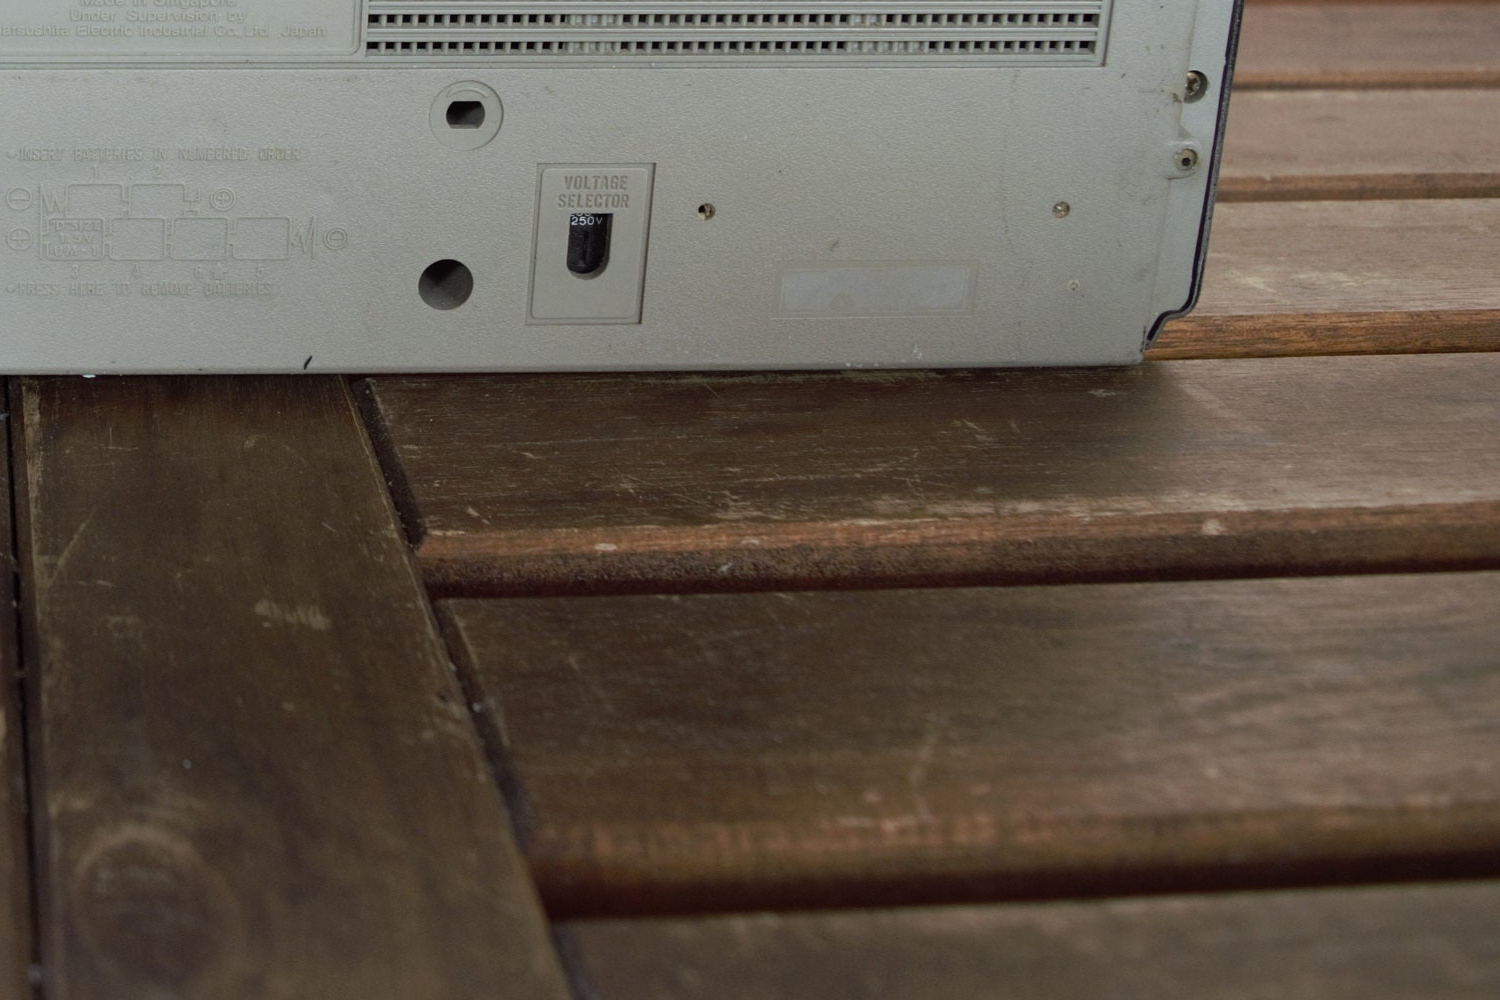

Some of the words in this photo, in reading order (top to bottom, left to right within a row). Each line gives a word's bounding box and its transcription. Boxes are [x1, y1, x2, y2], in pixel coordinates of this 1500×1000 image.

[70, 9, 118, 22] Under
[127, 10, 220, 26] Supervision
[228, 10, 247, 24] by
[76, 24, 133, 38] Electric
[139, 25, 207, 38] Industrial
[281, 25, 326, 40] Japan
[564, 175, 629, 191] VOLTAGE
[557, 193, 630, 209] SELECTOR
[571, 216, 603, 226] 250V
